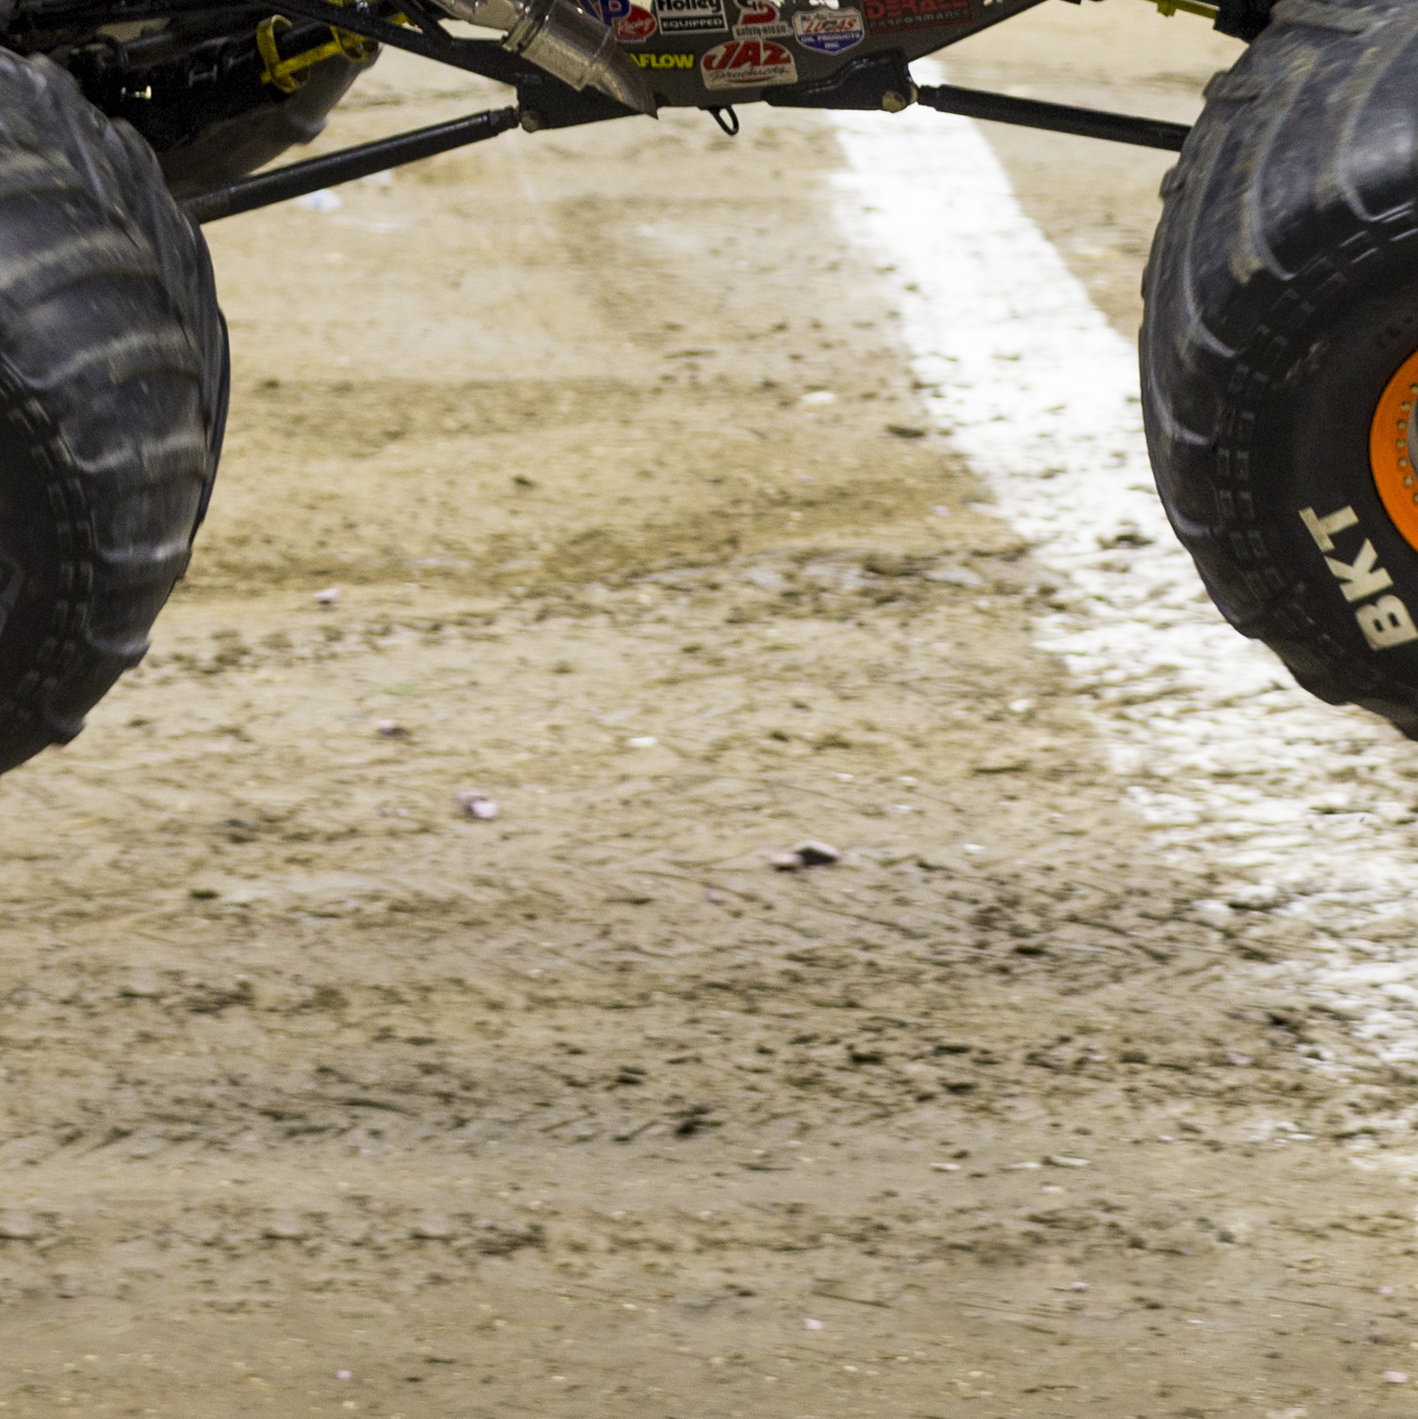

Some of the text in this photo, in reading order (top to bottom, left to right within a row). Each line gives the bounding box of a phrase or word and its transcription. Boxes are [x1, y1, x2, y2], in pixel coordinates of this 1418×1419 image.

[662, 17, 723, 30] EQUIPPED
[805, 18, 857, 33] LUCAS
[703, 41, 792, 71] JAZ
